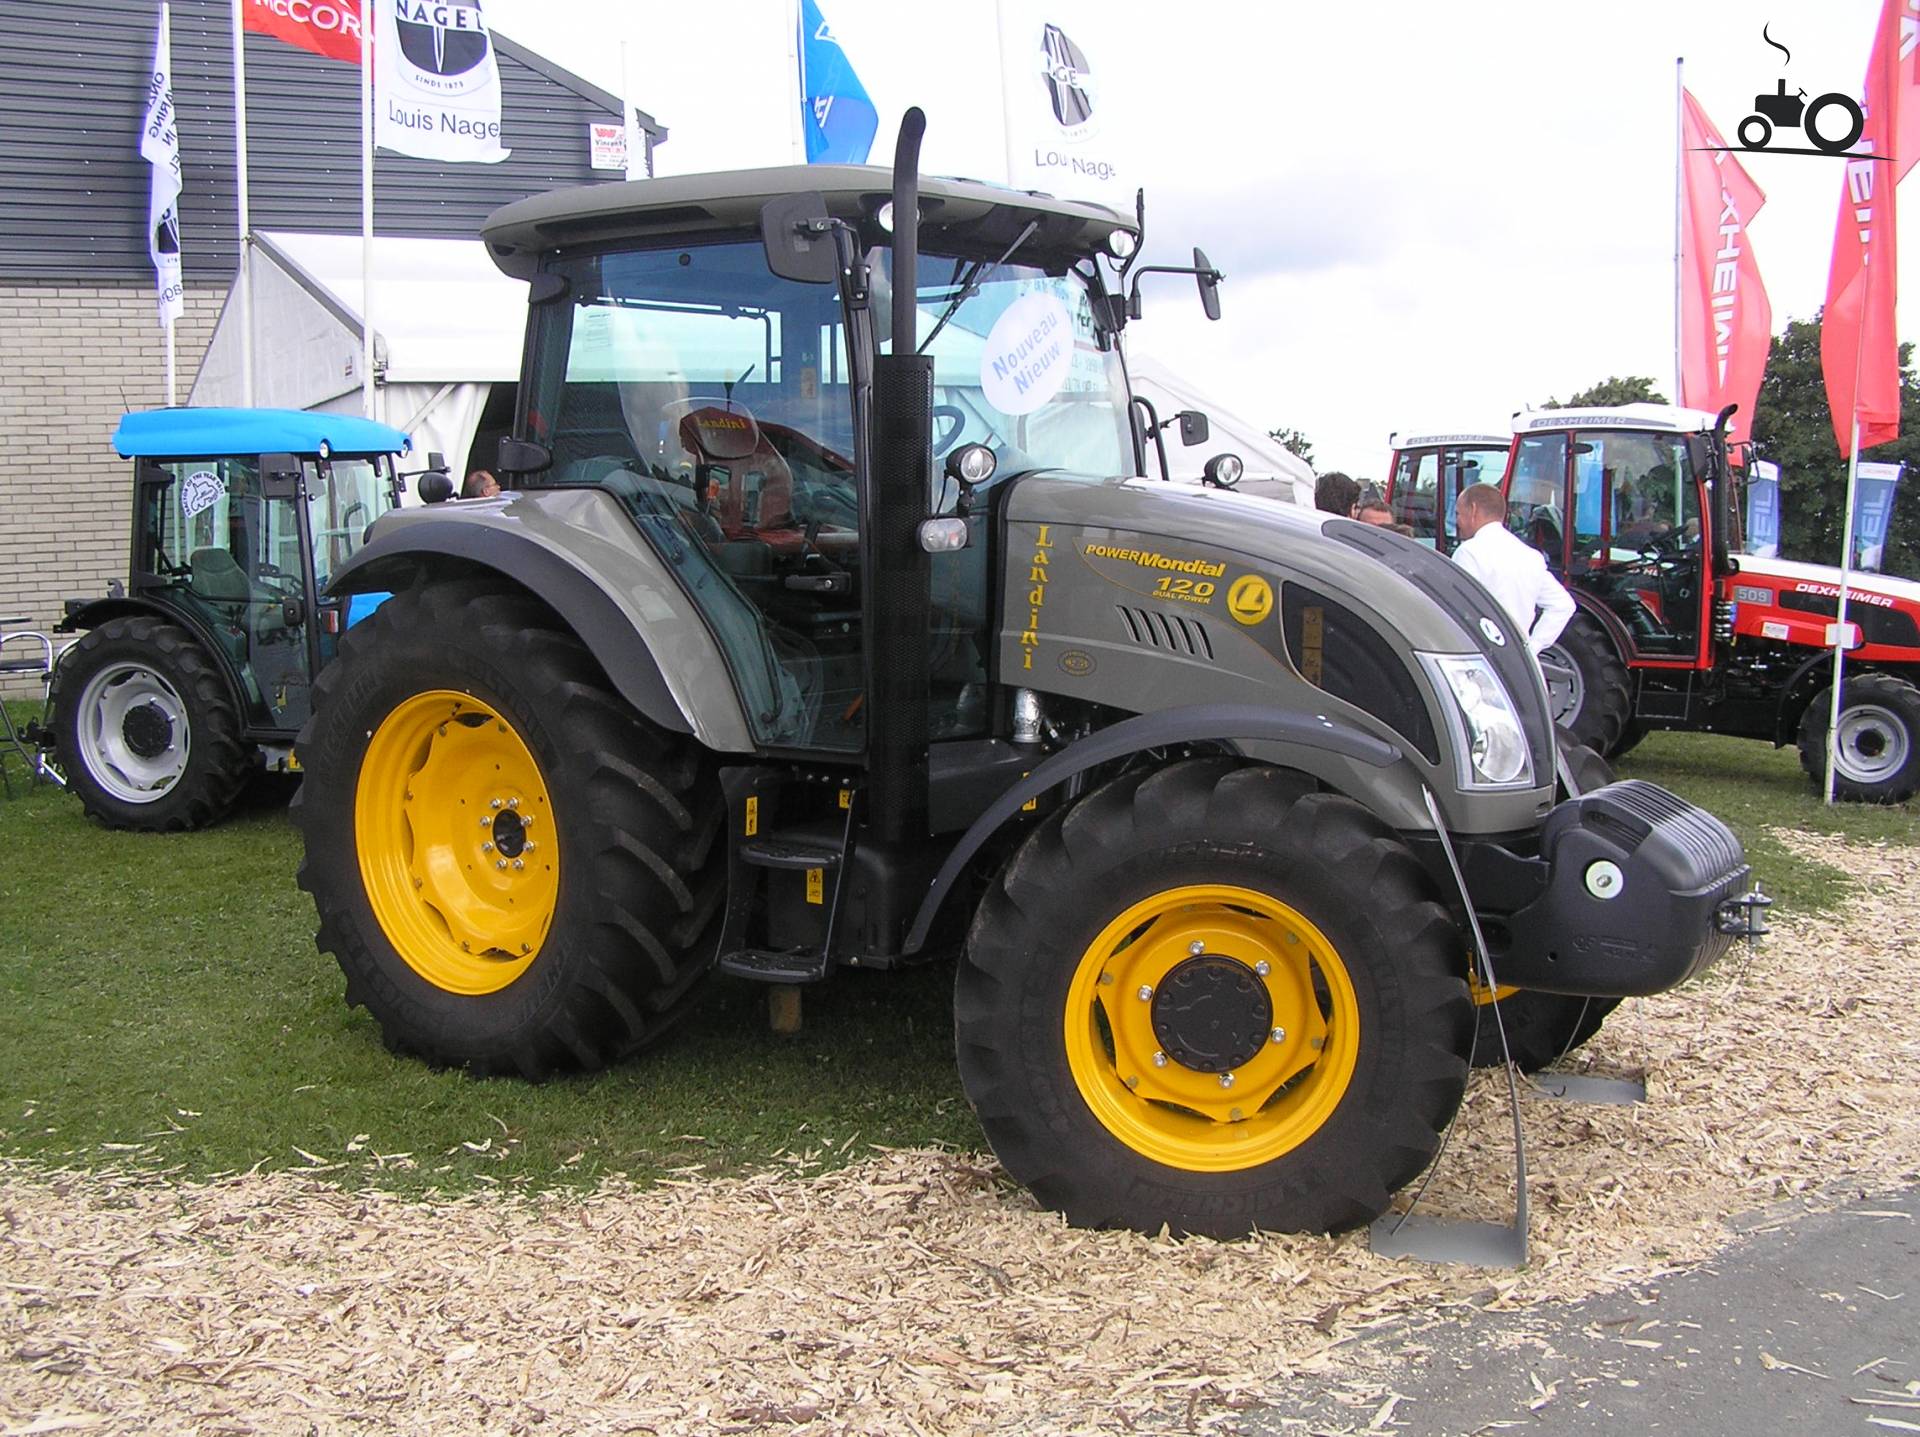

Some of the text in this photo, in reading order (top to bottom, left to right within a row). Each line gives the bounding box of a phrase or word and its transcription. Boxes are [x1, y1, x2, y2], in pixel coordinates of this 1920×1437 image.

[389, 100, 433, 130] Louis
[992, 311, 1058, 381] Nouveau
[1013, 341, 1061, 395] Nieuw
[1534, 416, 1627, 427] DEXHEIMER
[1020, 526, 1053, 670] Landini
[1152, 590, 1212, 605] DUAL POWER
[1156, 576, 1216, 597] 120
[1738, 588, 1768, 603] 509
